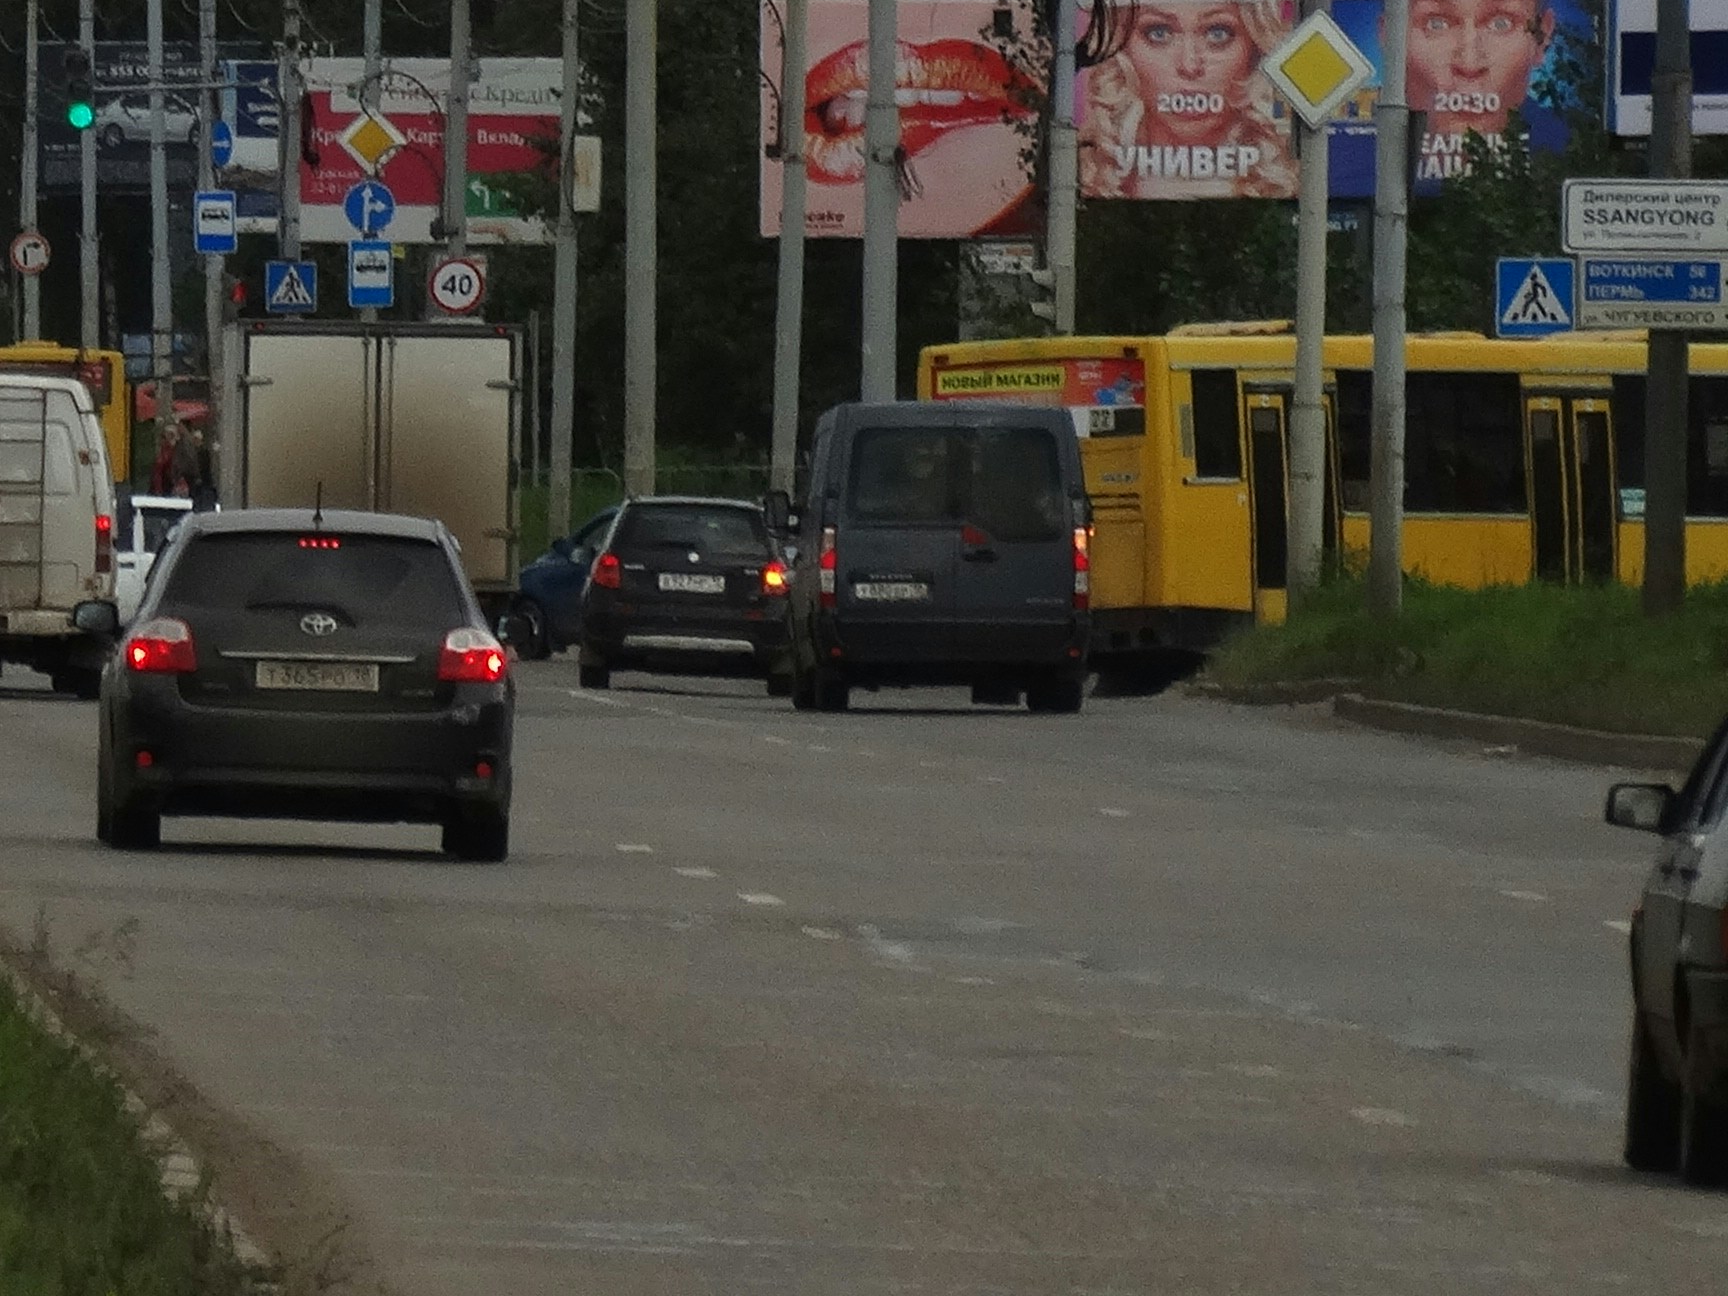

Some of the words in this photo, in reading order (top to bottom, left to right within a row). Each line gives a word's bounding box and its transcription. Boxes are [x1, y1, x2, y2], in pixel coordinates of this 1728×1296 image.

[1156, 92, 1224, 114] 20:00
[1435, 92, 1501, 114] 20:30
[1115, 144, 1261, 179] УНИВЕР
[1583, 190, 1671, 205] Дилерский
[1675, 193, 1721, 207] центр
[1582, 209, 1715, 226] SSANGYONG
[1588, 264, 1675, 279] ВОТКИНСК
[441, 274, 473, 296] 40
[1588, 285, 1645, 299] ПЕРМЬ
[1604, 310, 1716, 325] ЧУГУЕВСКОГО
[942, 374, 993, 391] НОВЫЙ
[996, 372, 1061, 389] МАГАЗИН
